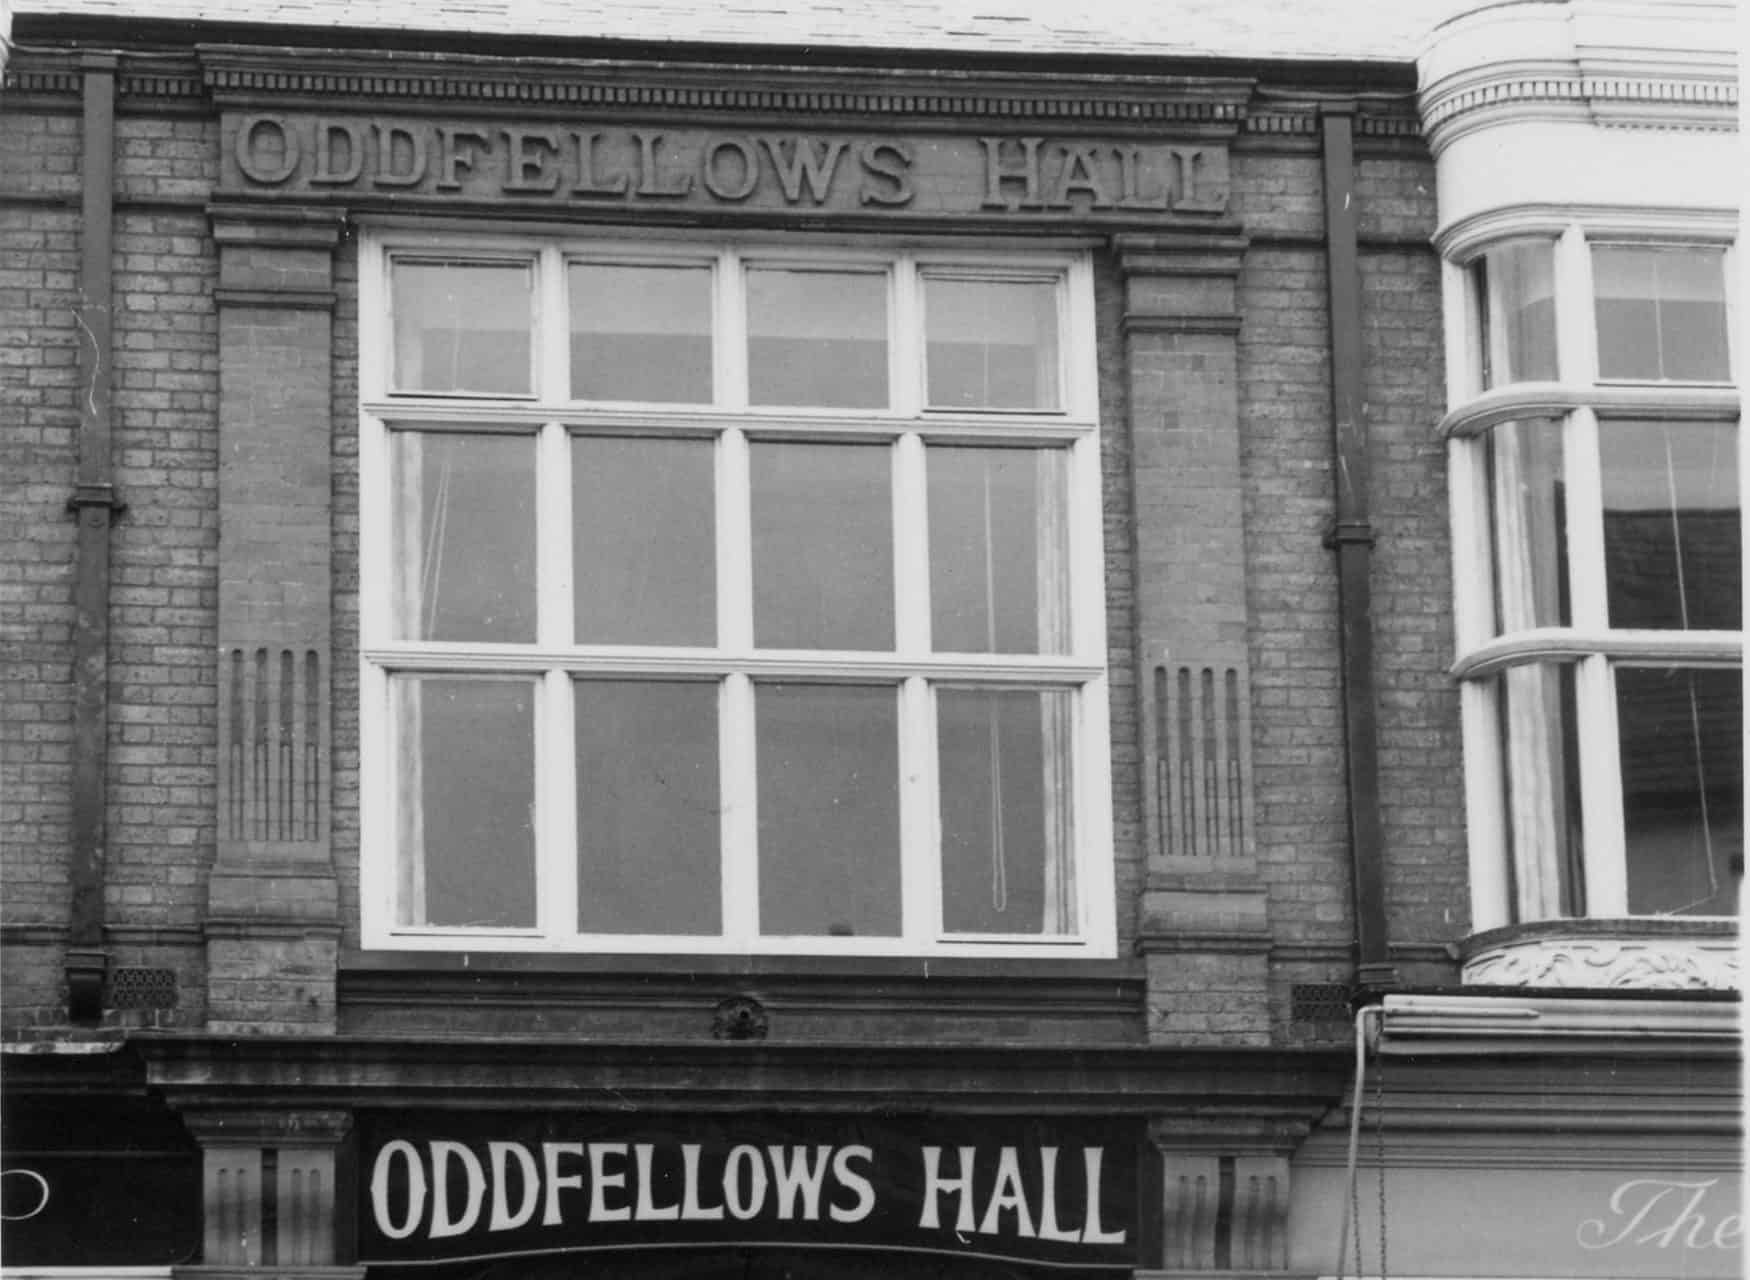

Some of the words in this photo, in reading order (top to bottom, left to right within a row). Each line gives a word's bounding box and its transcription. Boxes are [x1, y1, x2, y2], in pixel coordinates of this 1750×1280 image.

[235, 114, 914, 208] ODDFELLOWS
[977, 136, 1229, 215] HALL
[370, 1139, 876, 1240] ODDFELLOWS
[918, 1146, 1127, 1244] HALL
[1576, 1177, 1743, 1249] The
